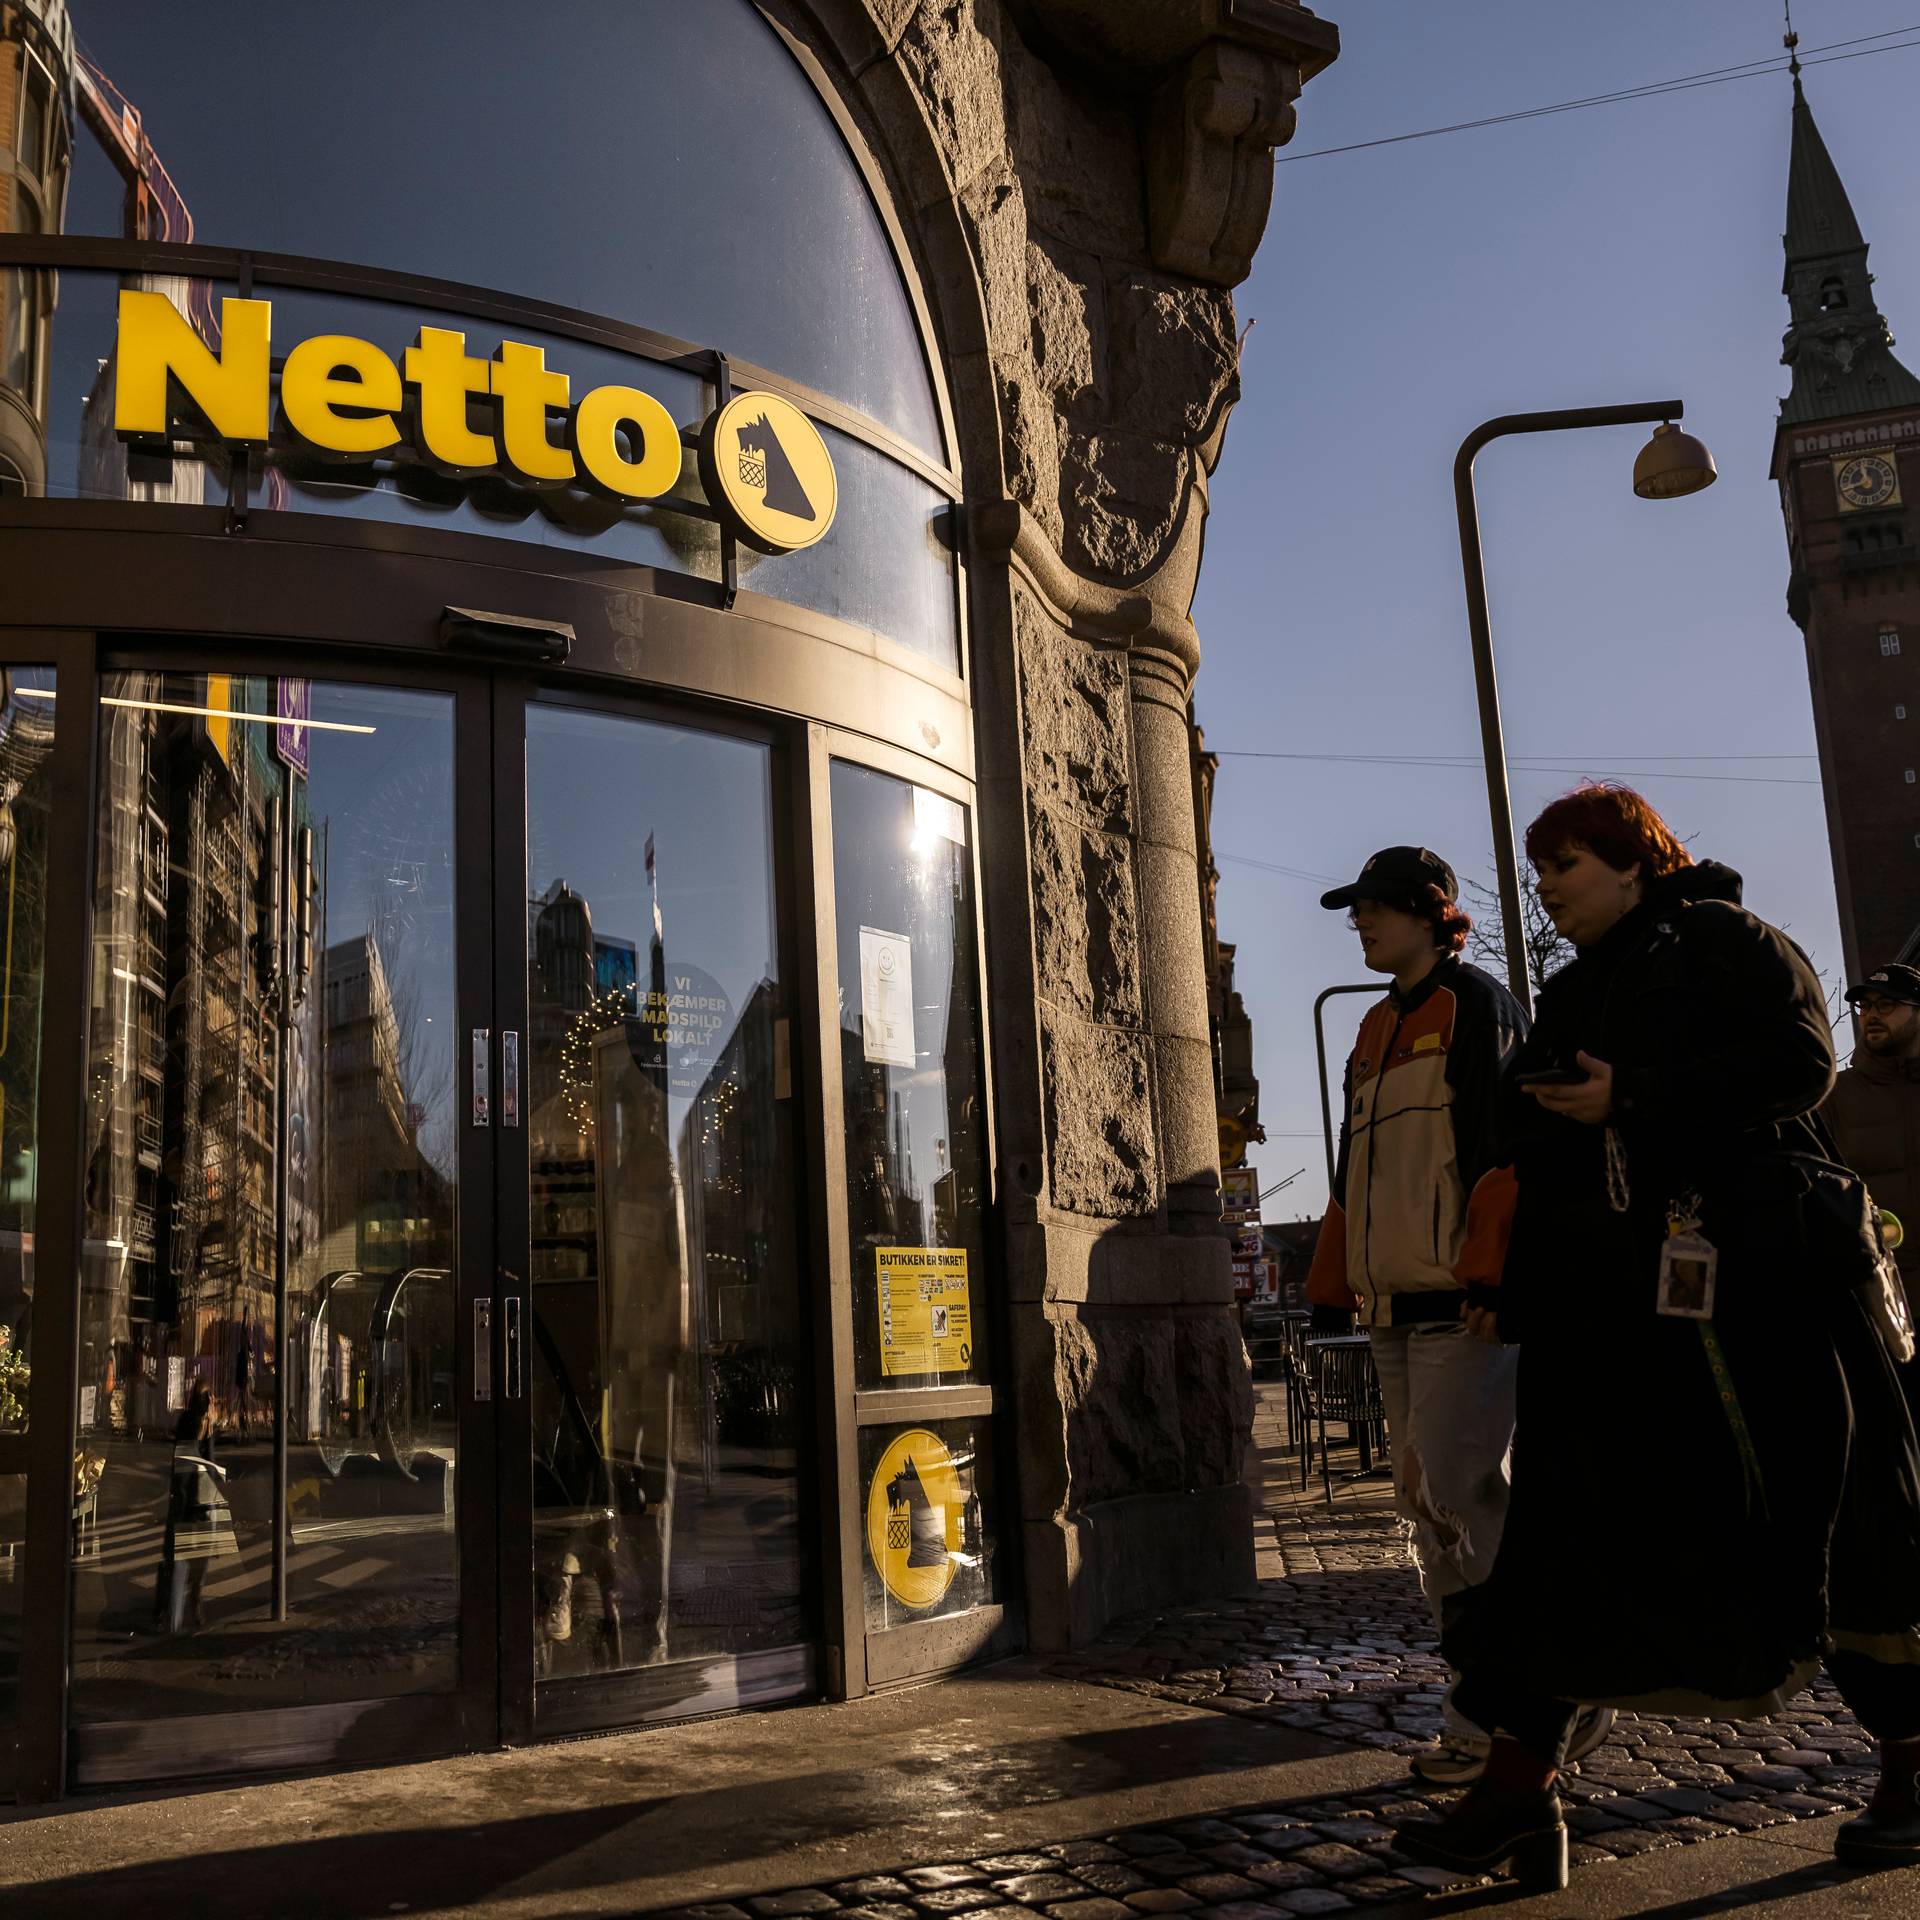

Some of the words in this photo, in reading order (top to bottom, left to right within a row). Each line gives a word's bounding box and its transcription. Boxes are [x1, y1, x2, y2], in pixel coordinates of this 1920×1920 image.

[114, 289, 682, 499] Netto
[674, 976, 691, 991] VI
[637, 991, 727, 1012] BEKÆMPER
[642, 1009, 723, 1029] MADSPILD
[653, 1028, 713, 1046] LOKALT
[880, 1254, 925, 1266] BUTIKKEN
[926, 1255, 937, 1266] ER
[938, 1255, 965, 1267] SIKRET!
